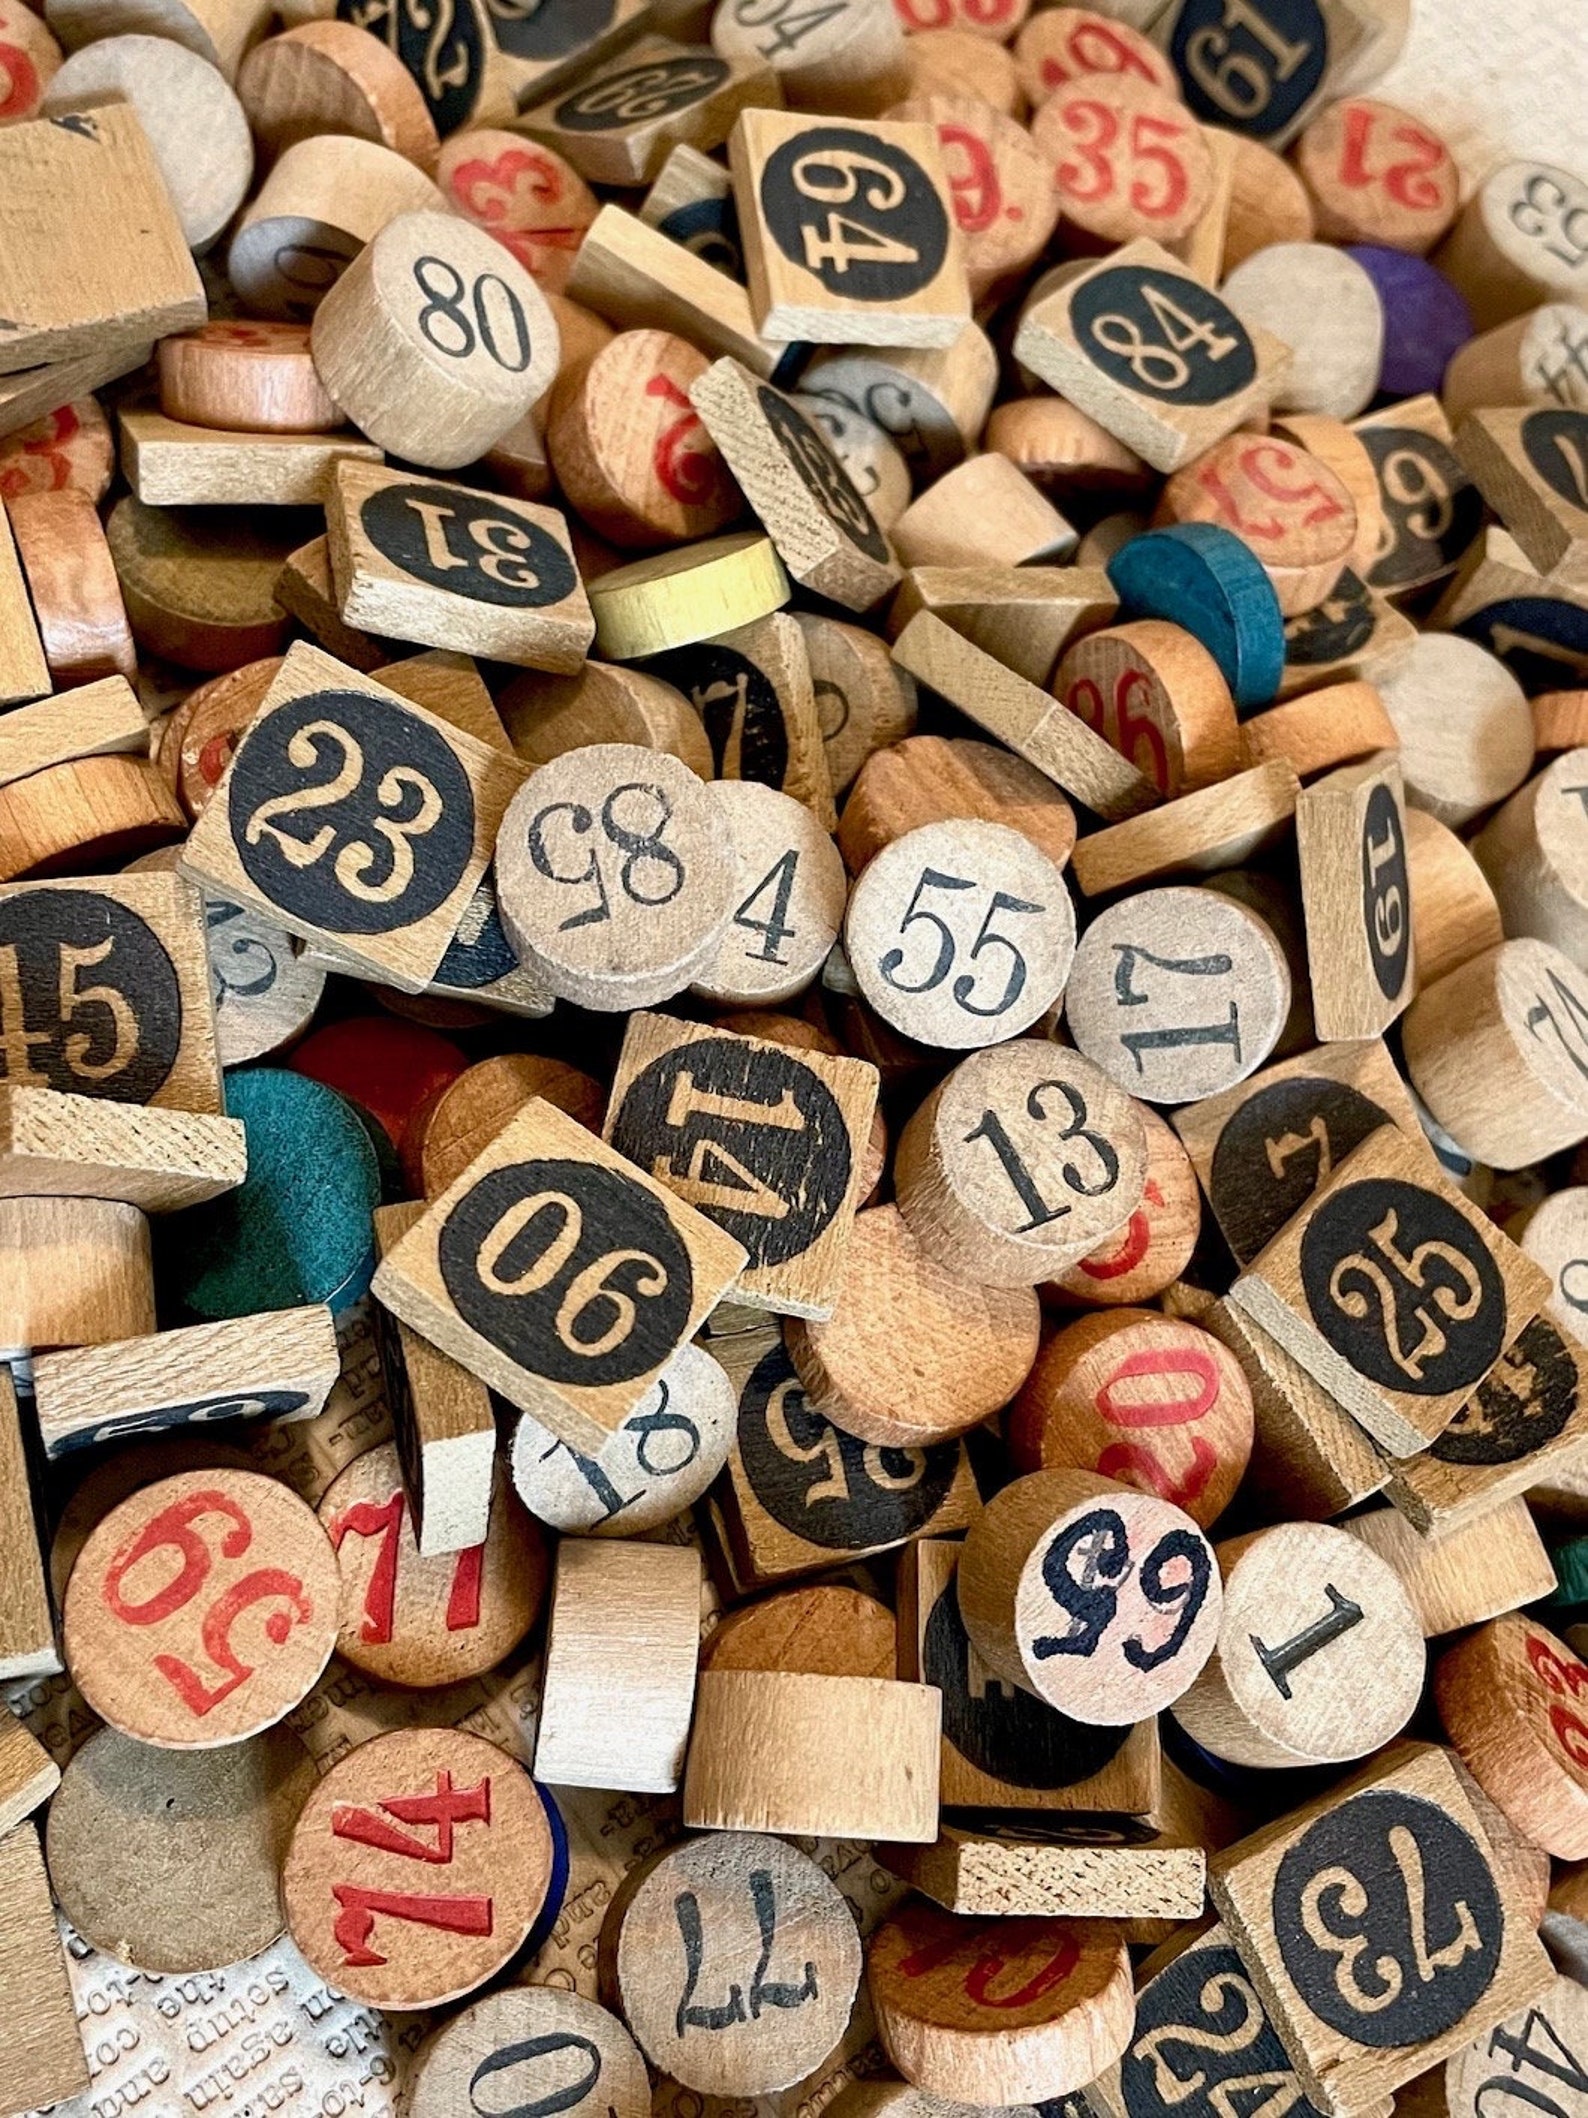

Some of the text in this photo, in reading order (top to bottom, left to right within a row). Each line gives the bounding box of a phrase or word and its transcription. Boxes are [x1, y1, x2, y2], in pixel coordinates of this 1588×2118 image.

[790, 149, 920, 275] 64
[1056, 100, 1188, 221] 35
[1339, 107, 1447, 211] 21
[413, 255, 532, 373] 80
[1091, 286, 1239, 390] 84
[246, 720, 443, 904] 23
[528, 783, 686, 932] 85
[733, 849, 796, 966] 4
[879, 867, 1046, 1017] 55
[1112, 943, 1242, 1076] 17
[964, 1079, 1119, 1234] 13
[1329, 1208, 1483, 1381] 25
[1248, 1582, 1367, 1701] 1
[675, 1869, 820, 2039] 77
[1301, 1824, 1484, 2014] 73
[183, 2017, 294, 2111] again
[185, 1964, 290, 2053] setup
